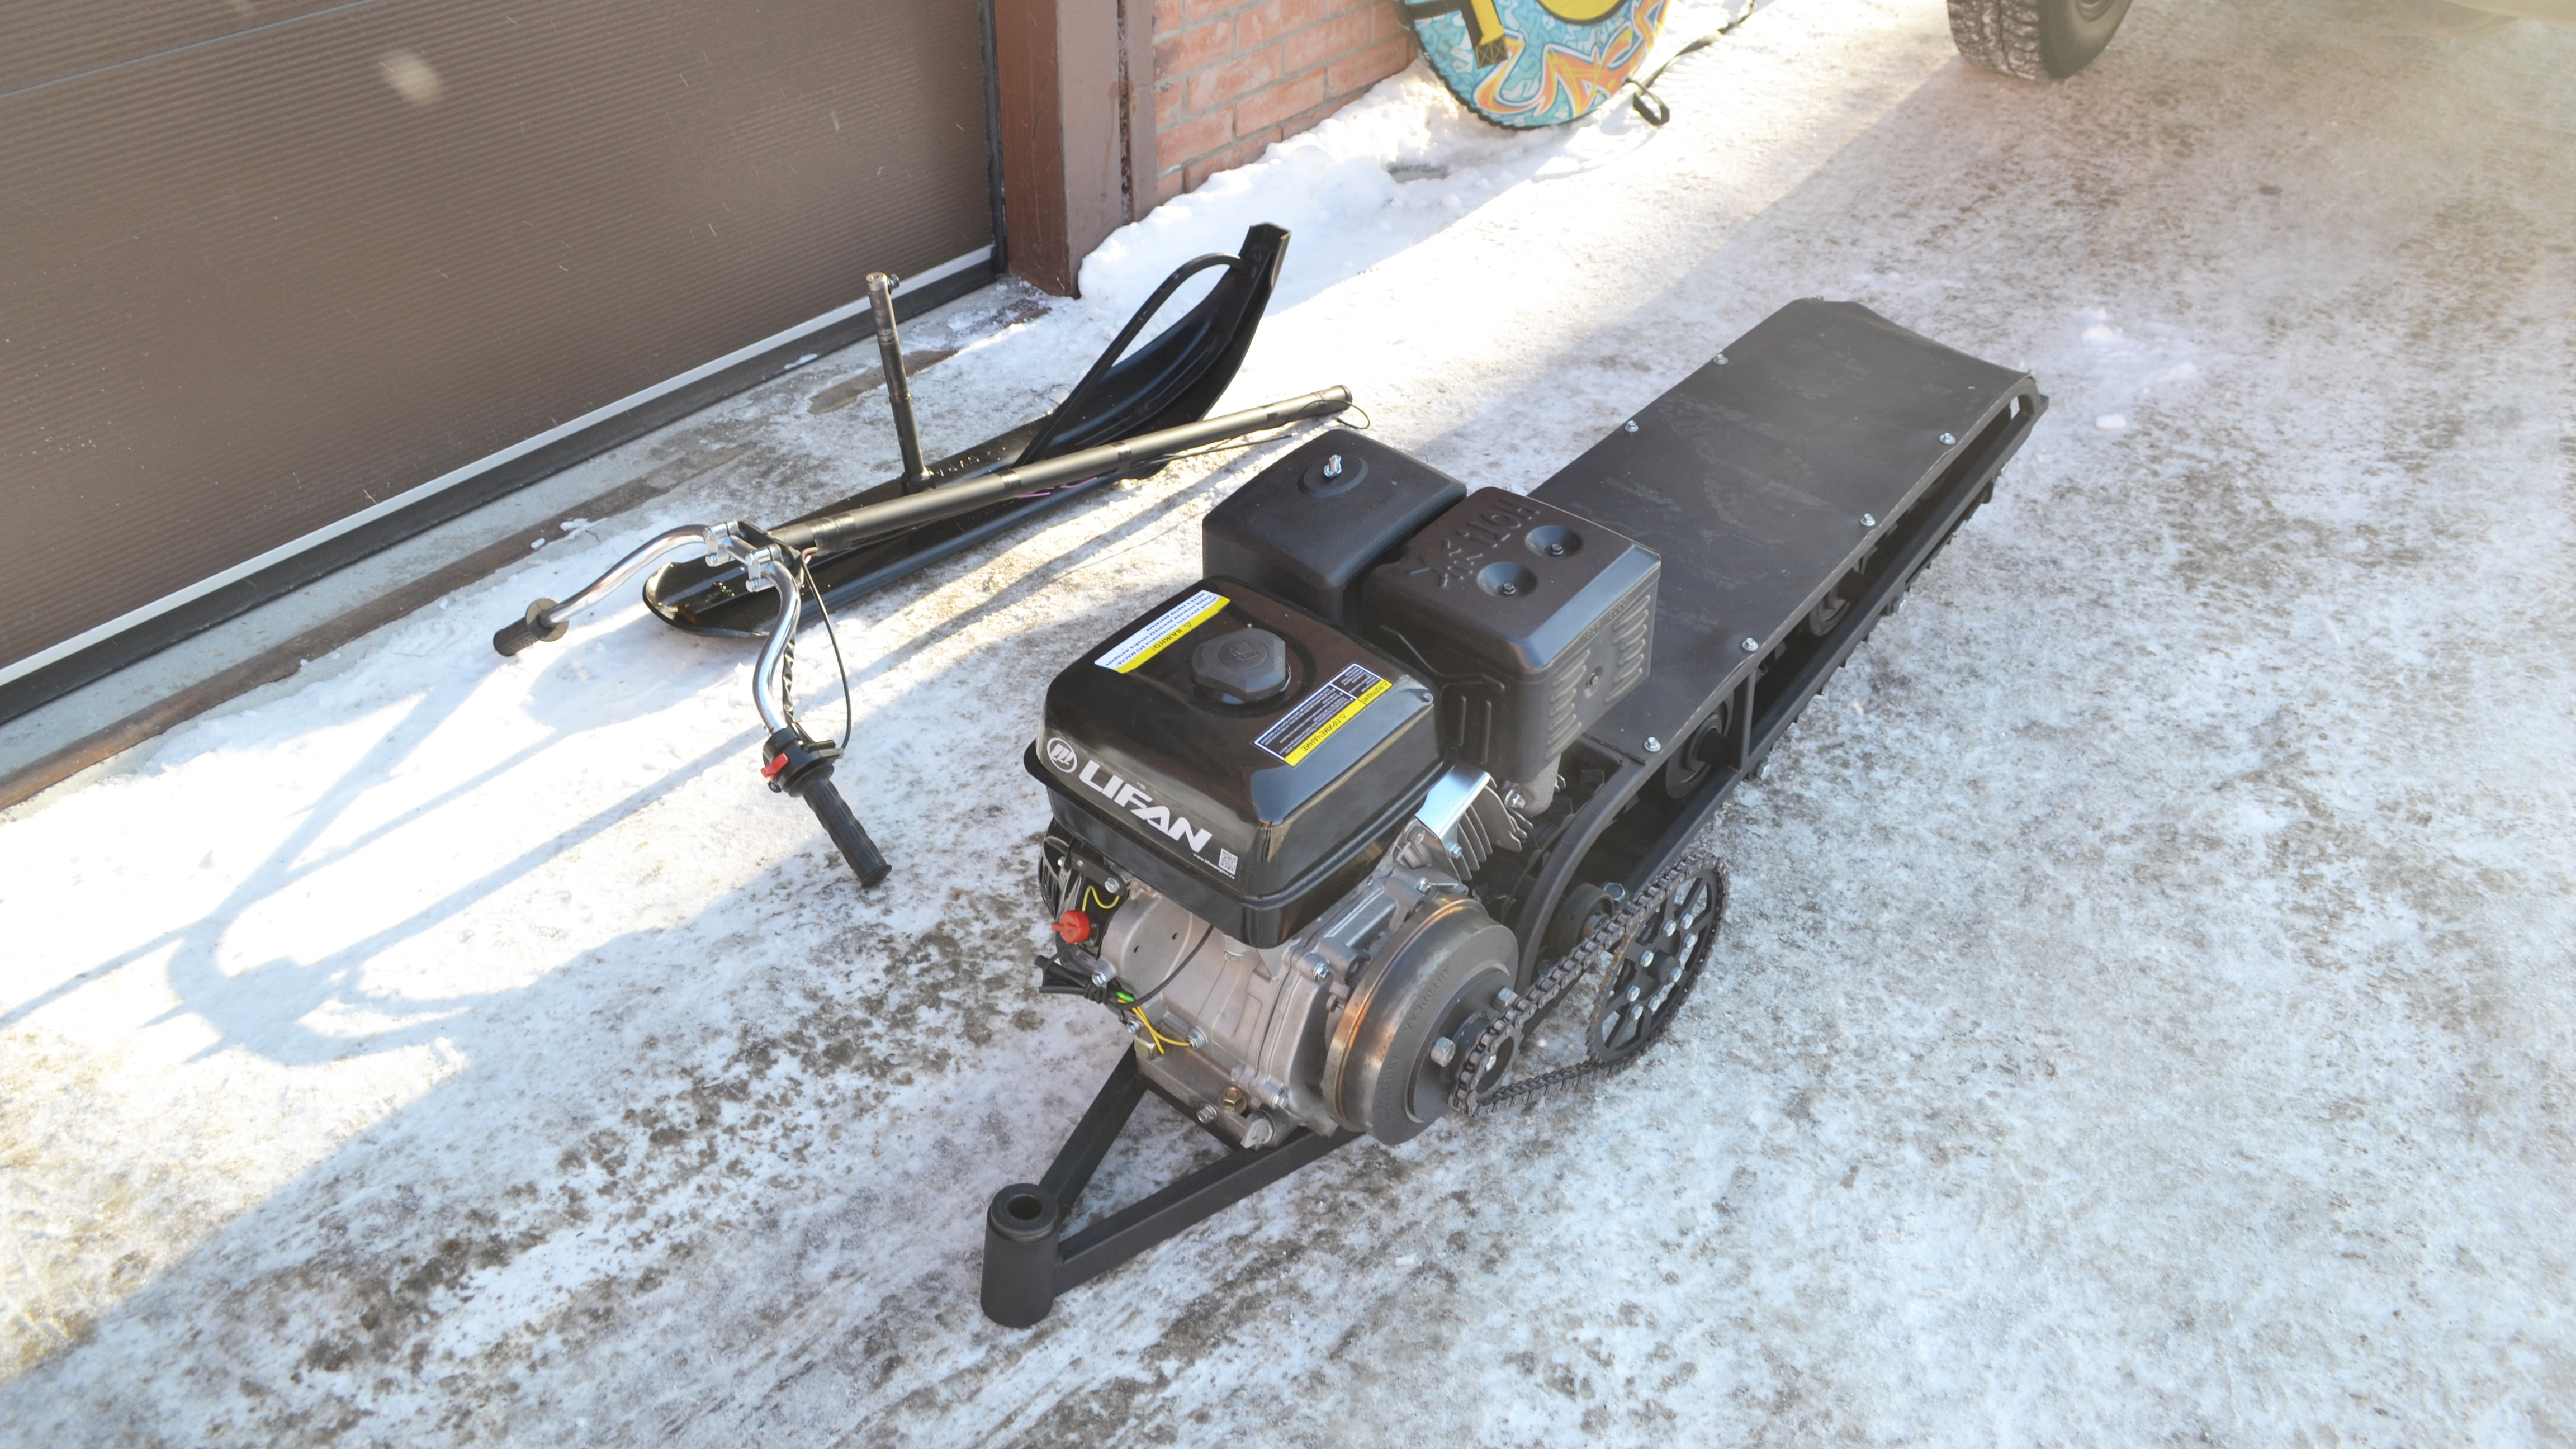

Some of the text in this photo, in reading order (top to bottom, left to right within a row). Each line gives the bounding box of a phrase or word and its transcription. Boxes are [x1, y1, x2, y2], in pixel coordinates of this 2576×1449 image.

[1456, 497, 1541, 549] HOT!
[1188, 592, 1206, 603] масло
[1168, 604, 1188, 615] картер
[1175, 607, 1202, 624] двигатель
[1103, 594, 1213, 666] Перед запуском двигателя залейте моторное
[1143, 623, 1178, 646] поставляется
[1148, 628, 1185, 651] ВАЖНО!
[1113, 651, 1138, 666] МАСЛА!
[1299, 717, 1342, 752] ПРИМЕЧАНИЕ
[1079, 759, 1213, 853] LIFAN
